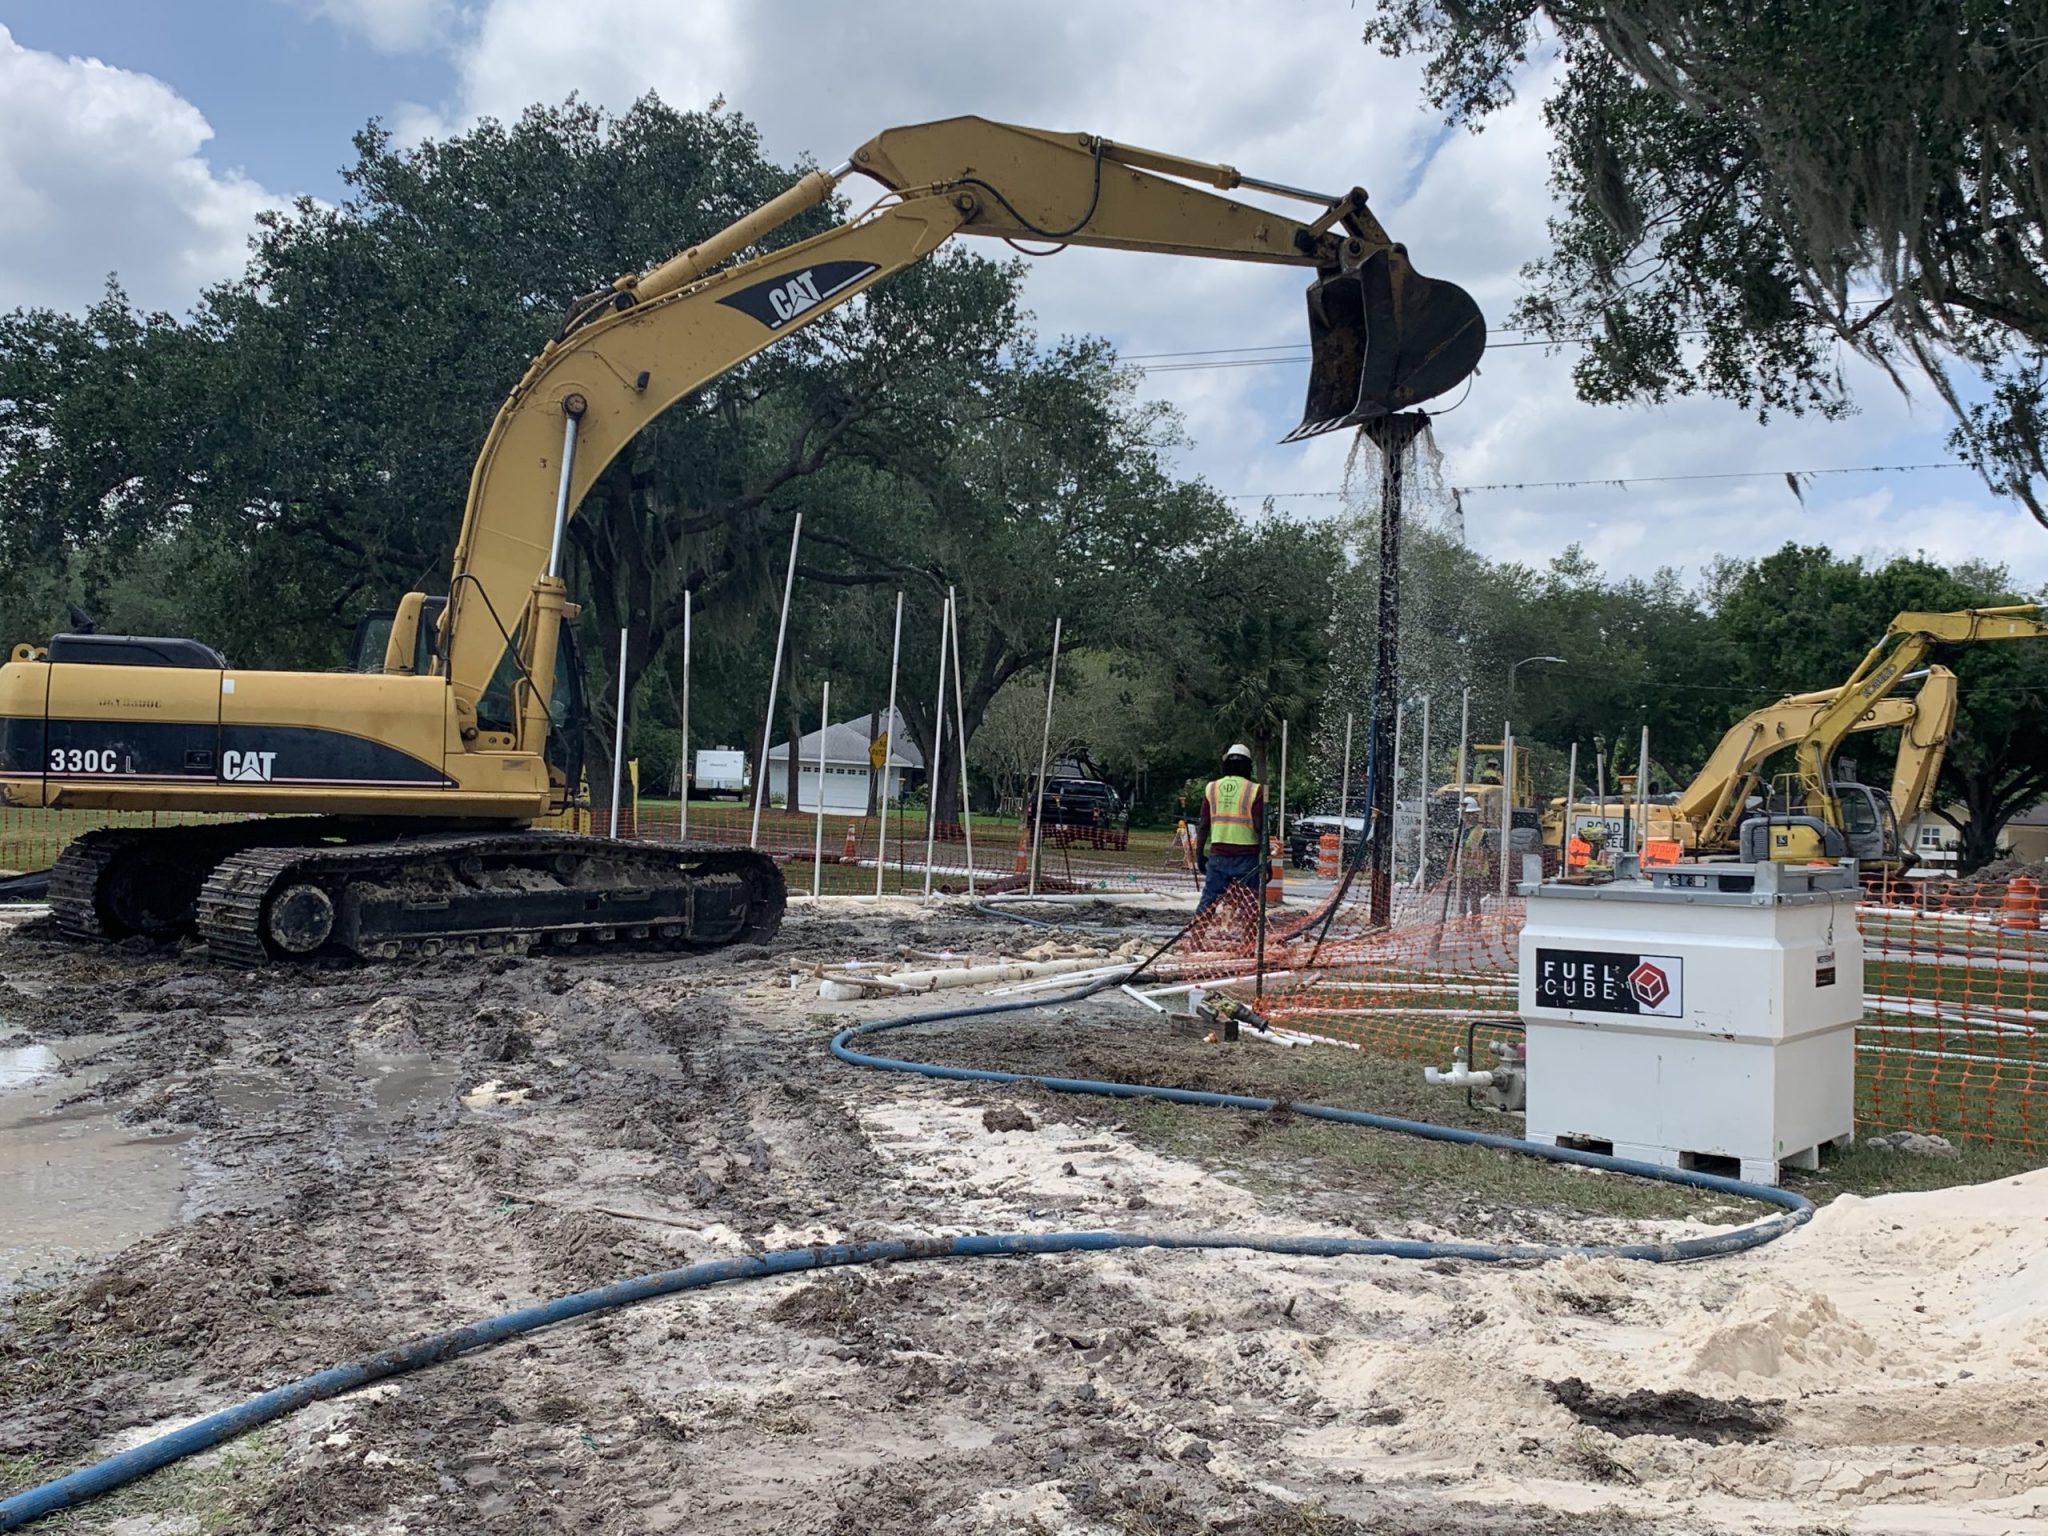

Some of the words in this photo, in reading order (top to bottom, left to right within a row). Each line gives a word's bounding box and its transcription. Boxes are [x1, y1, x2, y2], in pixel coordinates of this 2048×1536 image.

[768, 270, 822, 321] CAT
[50, 749, 117, 773] 330C
[223, 750, 277, 782] CAT
[1544, 961, 1615, 982] FUEL
[1544, 979, 1615, 1000] CUBE
